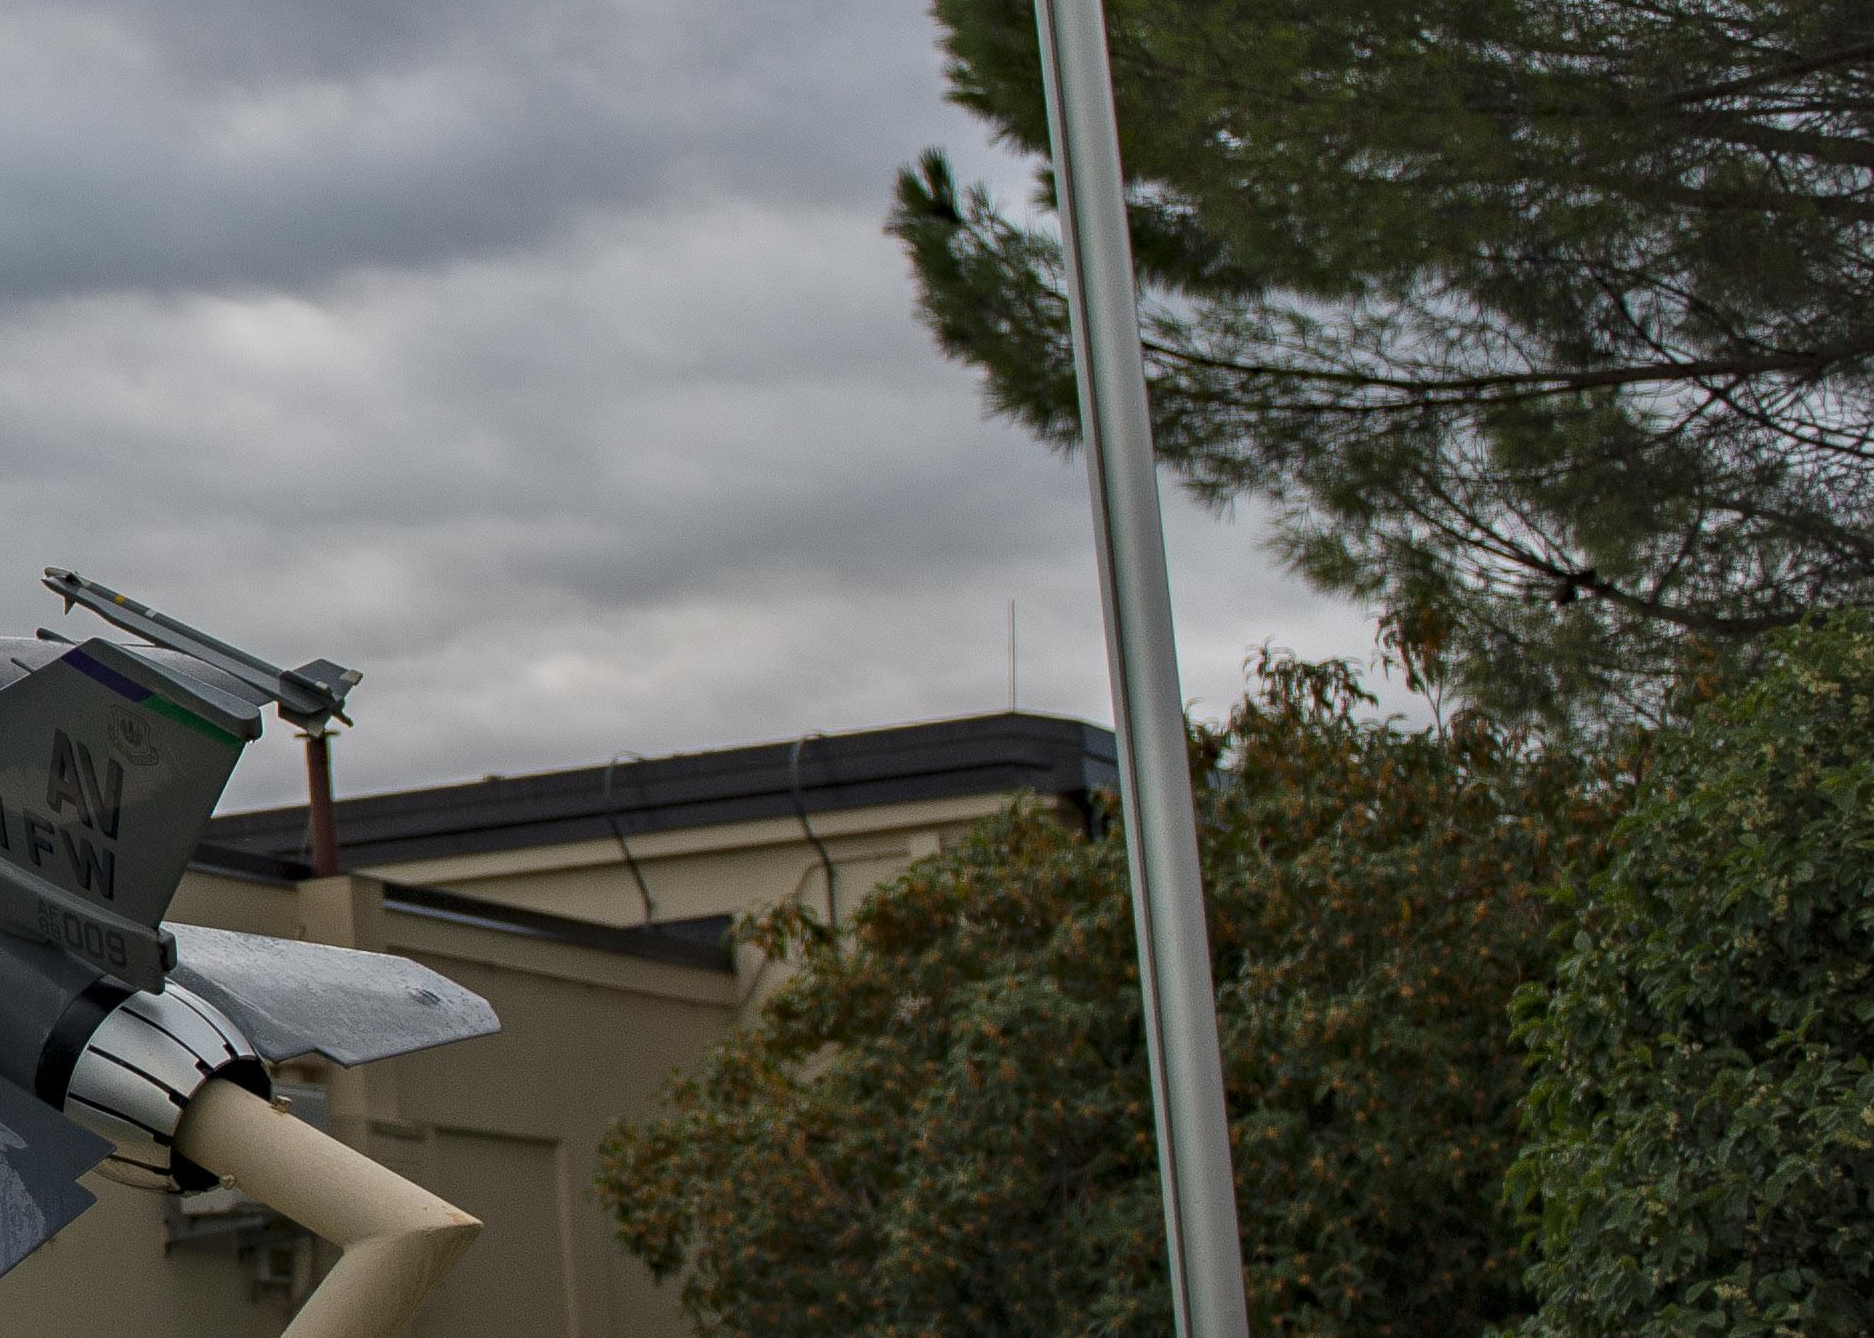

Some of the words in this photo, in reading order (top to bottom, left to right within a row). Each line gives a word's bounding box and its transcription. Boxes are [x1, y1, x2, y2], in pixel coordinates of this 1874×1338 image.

[47, 727, 125, 841] AV
[22, 807, 116, 901] FW
[63, 911, 128, 969] 009
